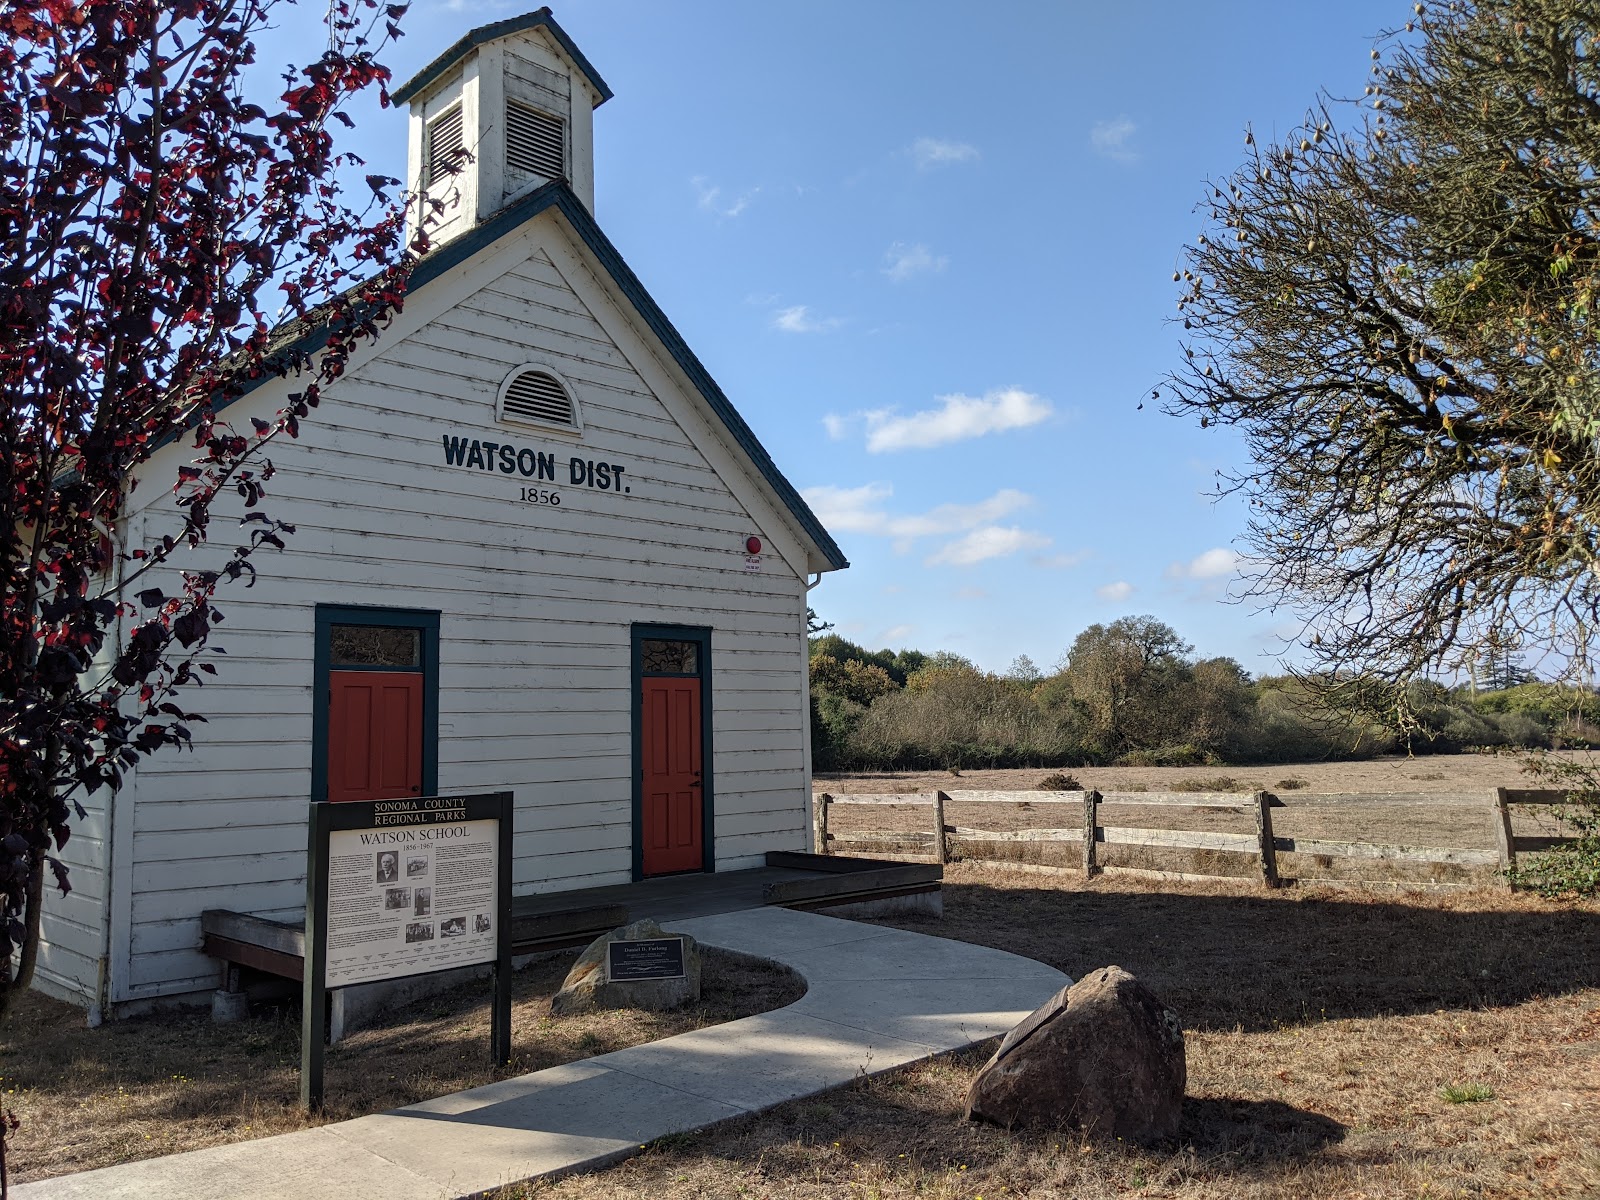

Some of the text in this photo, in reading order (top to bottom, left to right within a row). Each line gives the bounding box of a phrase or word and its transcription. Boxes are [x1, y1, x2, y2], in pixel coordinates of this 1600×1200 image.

[443, 434, 631, 493] WATSON DIST.
[519, 487, 561, 506] 1856
[374, 798, 466, 812] SONOMA COUNTY
[374, 810, 466, 825] REGIONAL PARKS
[360, 826, 471, 845] WATSON SCHOOL
[403, 842, 434, 852] 1856-1967
